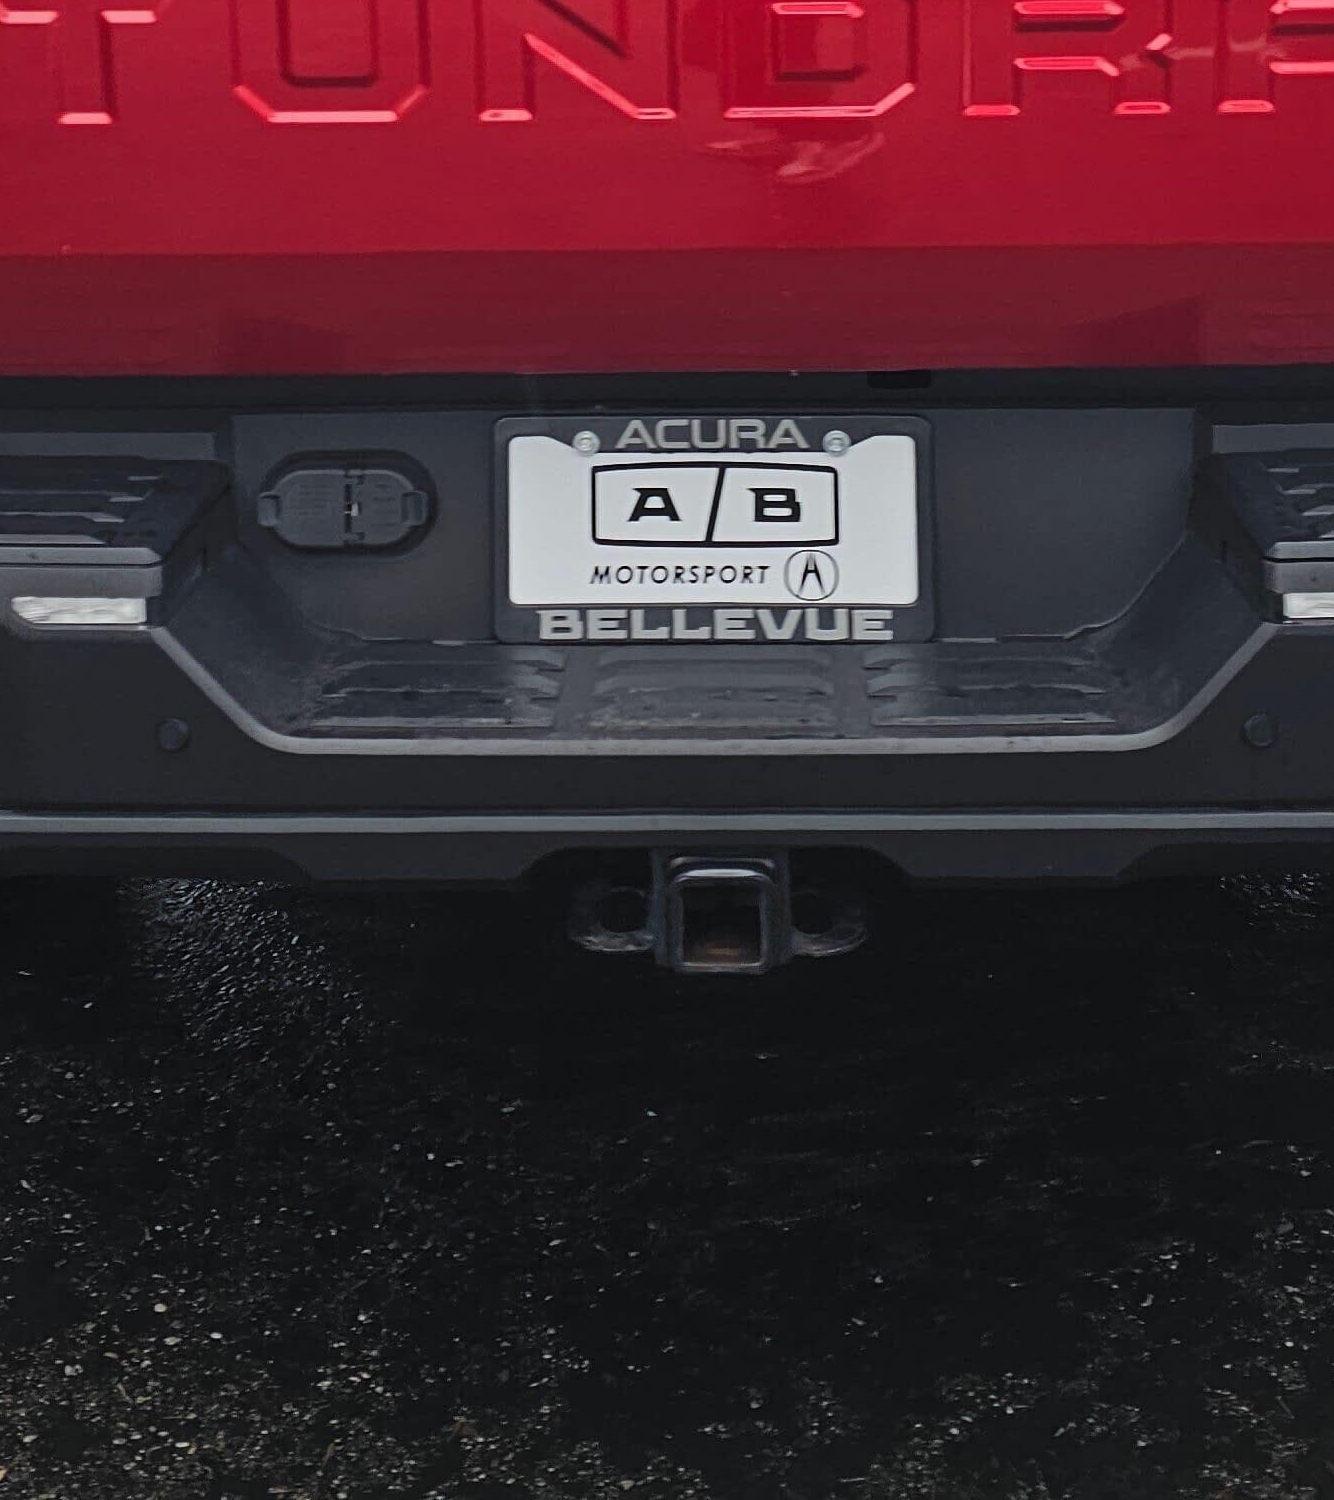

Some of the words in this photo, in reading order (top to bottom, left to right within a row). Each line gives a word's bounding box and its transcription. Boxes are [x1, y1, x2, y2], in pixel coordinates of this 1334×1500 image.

[614, 418, 810, 450] ACURA
[589, 564, 771, 585] MOTORSPORT
[536, 608, 894, 642] BELLEVUE
